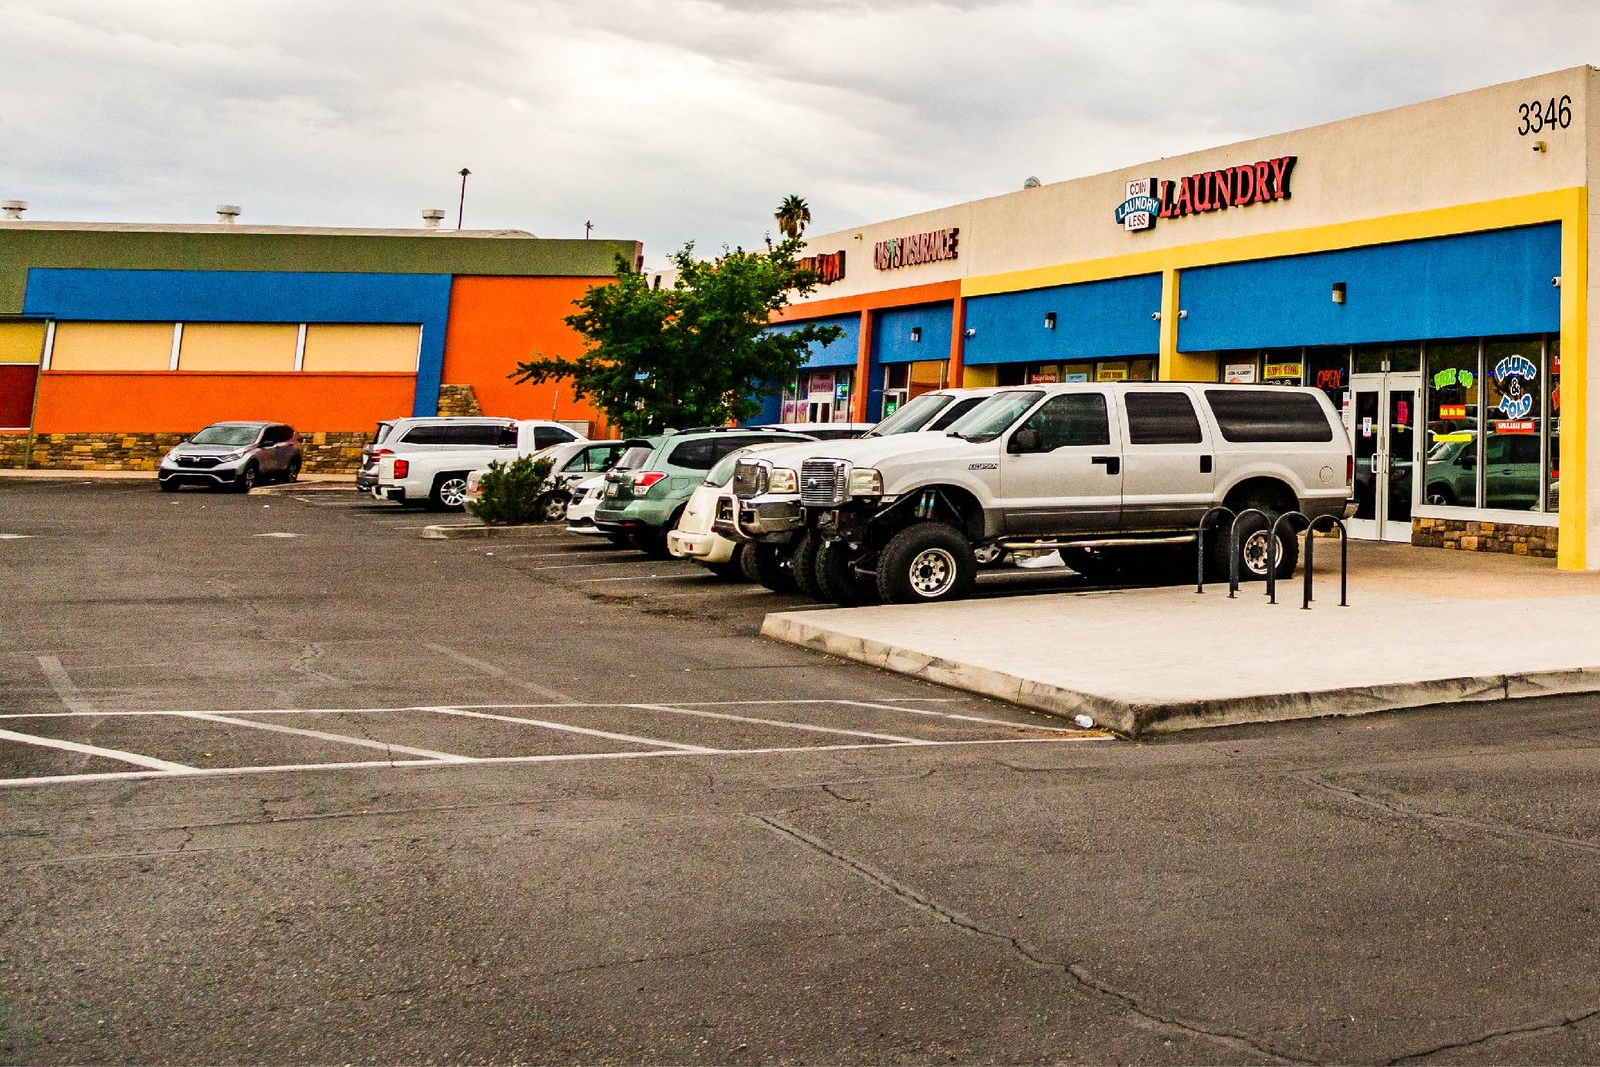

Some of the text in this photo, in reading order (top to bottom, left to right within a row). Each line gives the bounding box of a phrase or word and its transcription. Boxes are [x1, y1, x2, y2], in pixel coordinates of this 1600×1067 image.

[1518, 94, 1571, 136] 3346
[1129, 180, 1146, 195] COIN
[1159, 156, 1297, 219] LAUNDRY
[1118, 197, 1158, 218] LAUNDRY
[1128, 213, 1146, 228] LESS
[1316, 369, 1341, 388] OPEN
[1495, 354, 1537, 382] FLUFF
[1510, 377, 1520, 395] &
[1499, 394, 1532, 419] FOLD
